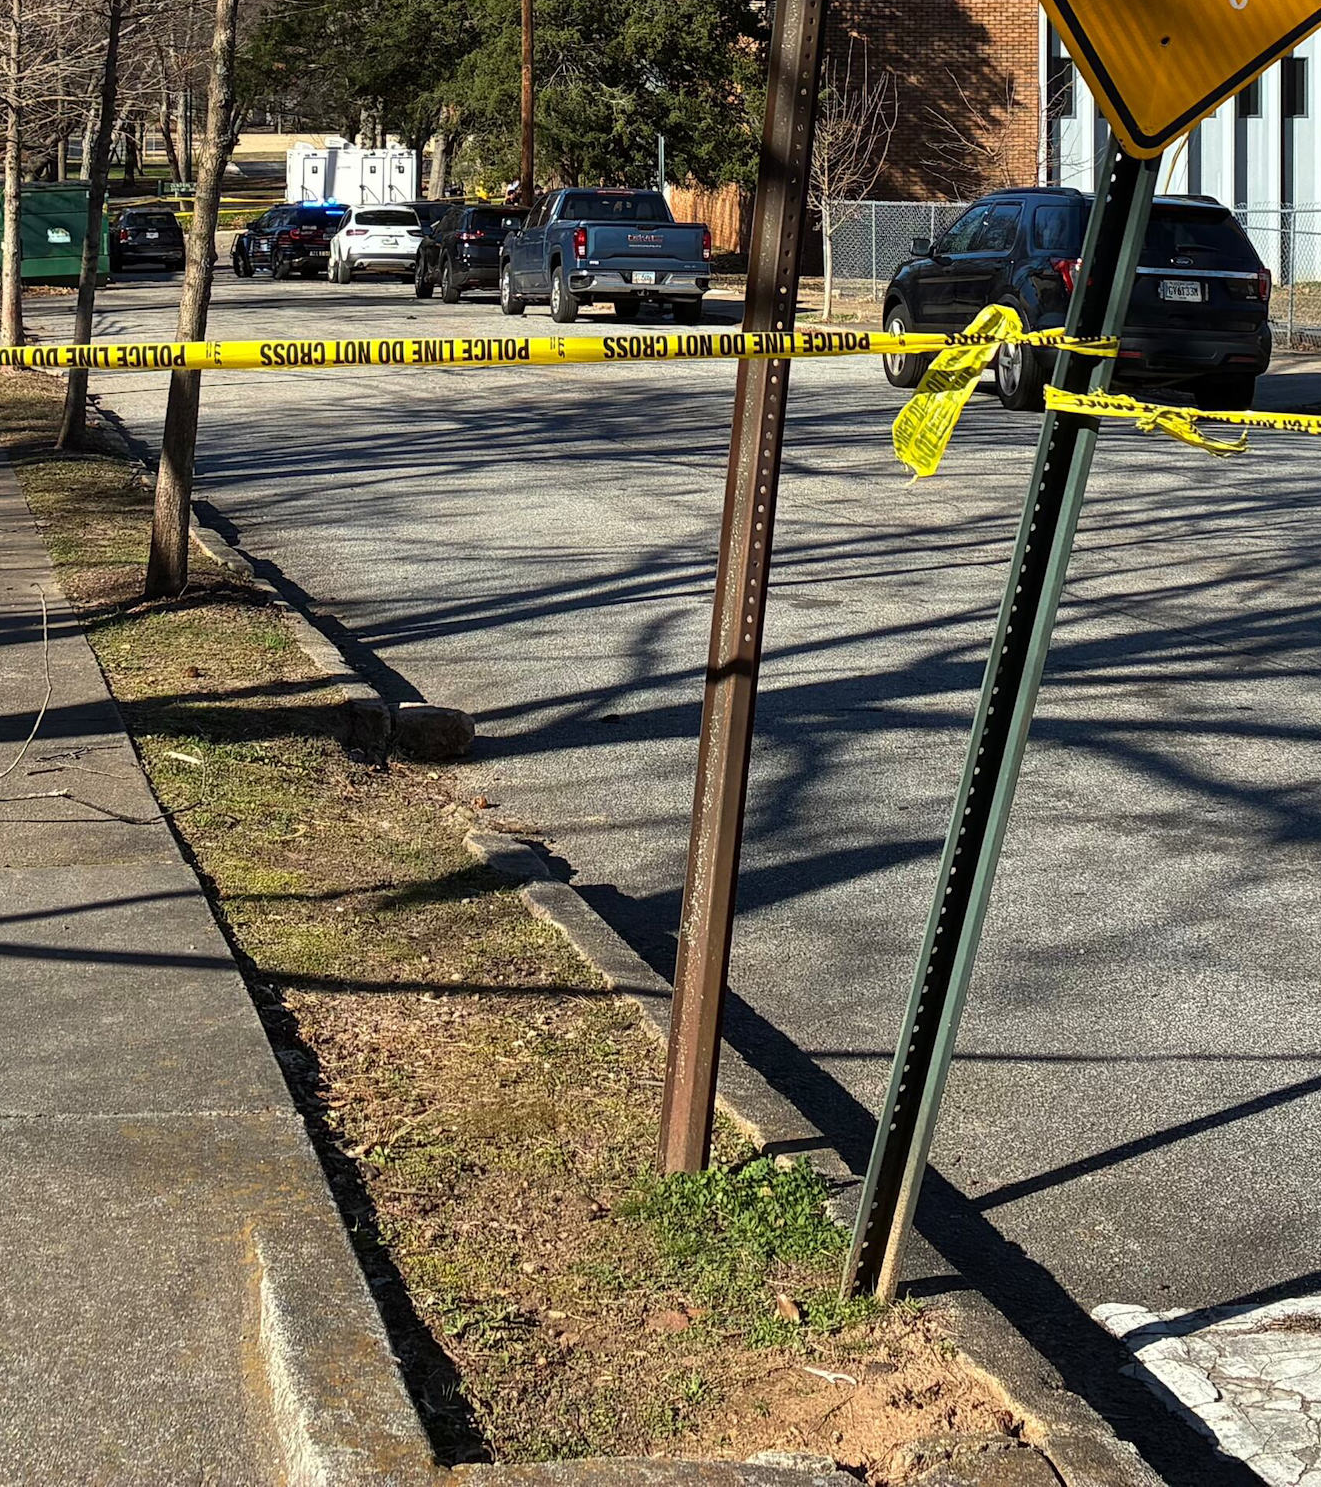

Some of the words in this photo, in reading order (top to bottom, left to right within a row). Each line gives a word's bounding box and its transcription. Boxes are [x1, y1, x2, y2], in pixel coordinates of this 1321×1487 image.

[333, 341, 371, 364] NOT
[378, 340, 407, 363] DO
[412, 339, 455, 363] LINE
[462, 339, 530, 361] POLICE
[603, 336, 668, 359] CROSS
[675, 334, 713, 357] NOT
[719, 334, 746, 355] DO
[753, 333, 796, 354] LINE
[803, 332, 870, 352] POLICE
[32, 347, 60, 366] DO
[66, 346, 110, 367] LINE
[117, 345, 186, 367] POLICE
[260, 342, 326, 366] CROSS
